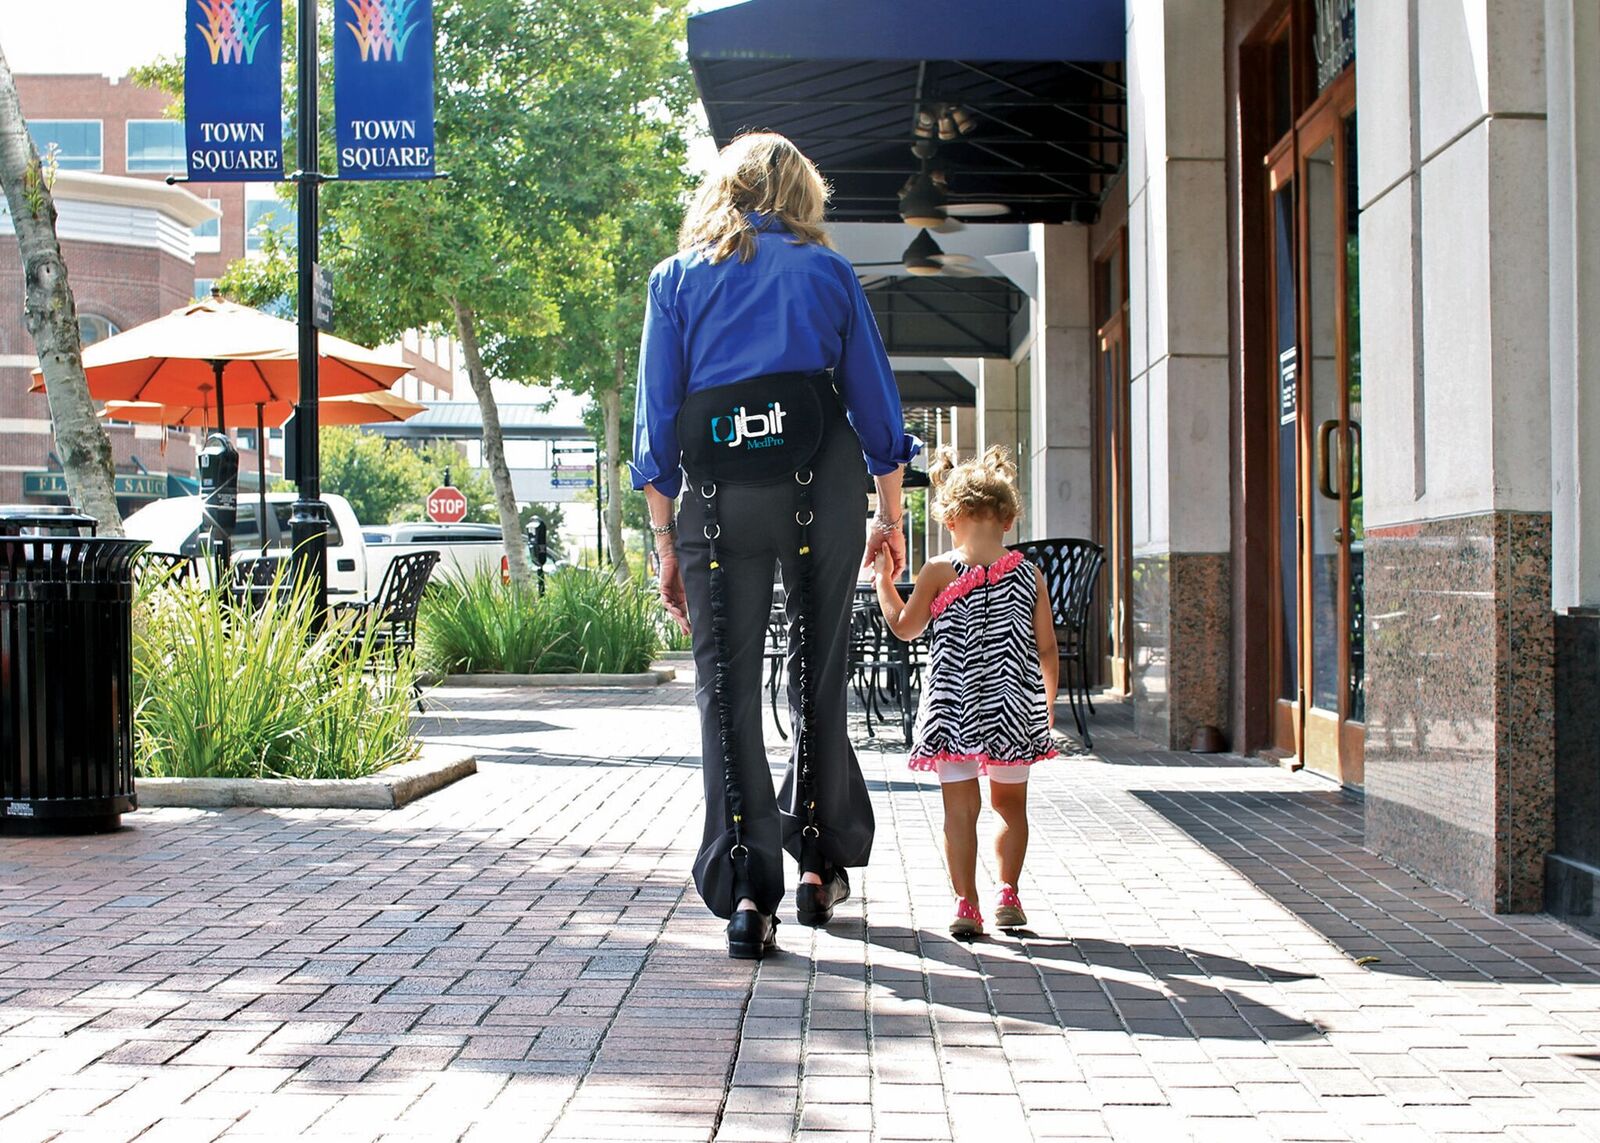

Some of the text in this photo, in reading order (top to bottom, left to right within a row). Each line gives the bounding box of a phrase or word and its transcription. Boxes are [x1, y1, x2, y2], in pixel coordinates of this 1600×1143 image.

[201, 123, 265, 142] TOWN
[351, 120, 416, 140] TOWN
[192, 150, 278, 172] SQUARE
[342, 147, 430, 170] SQUARE
[747, 436, 785, 449] MedPro
[430, 499, 464, 514] STOP
